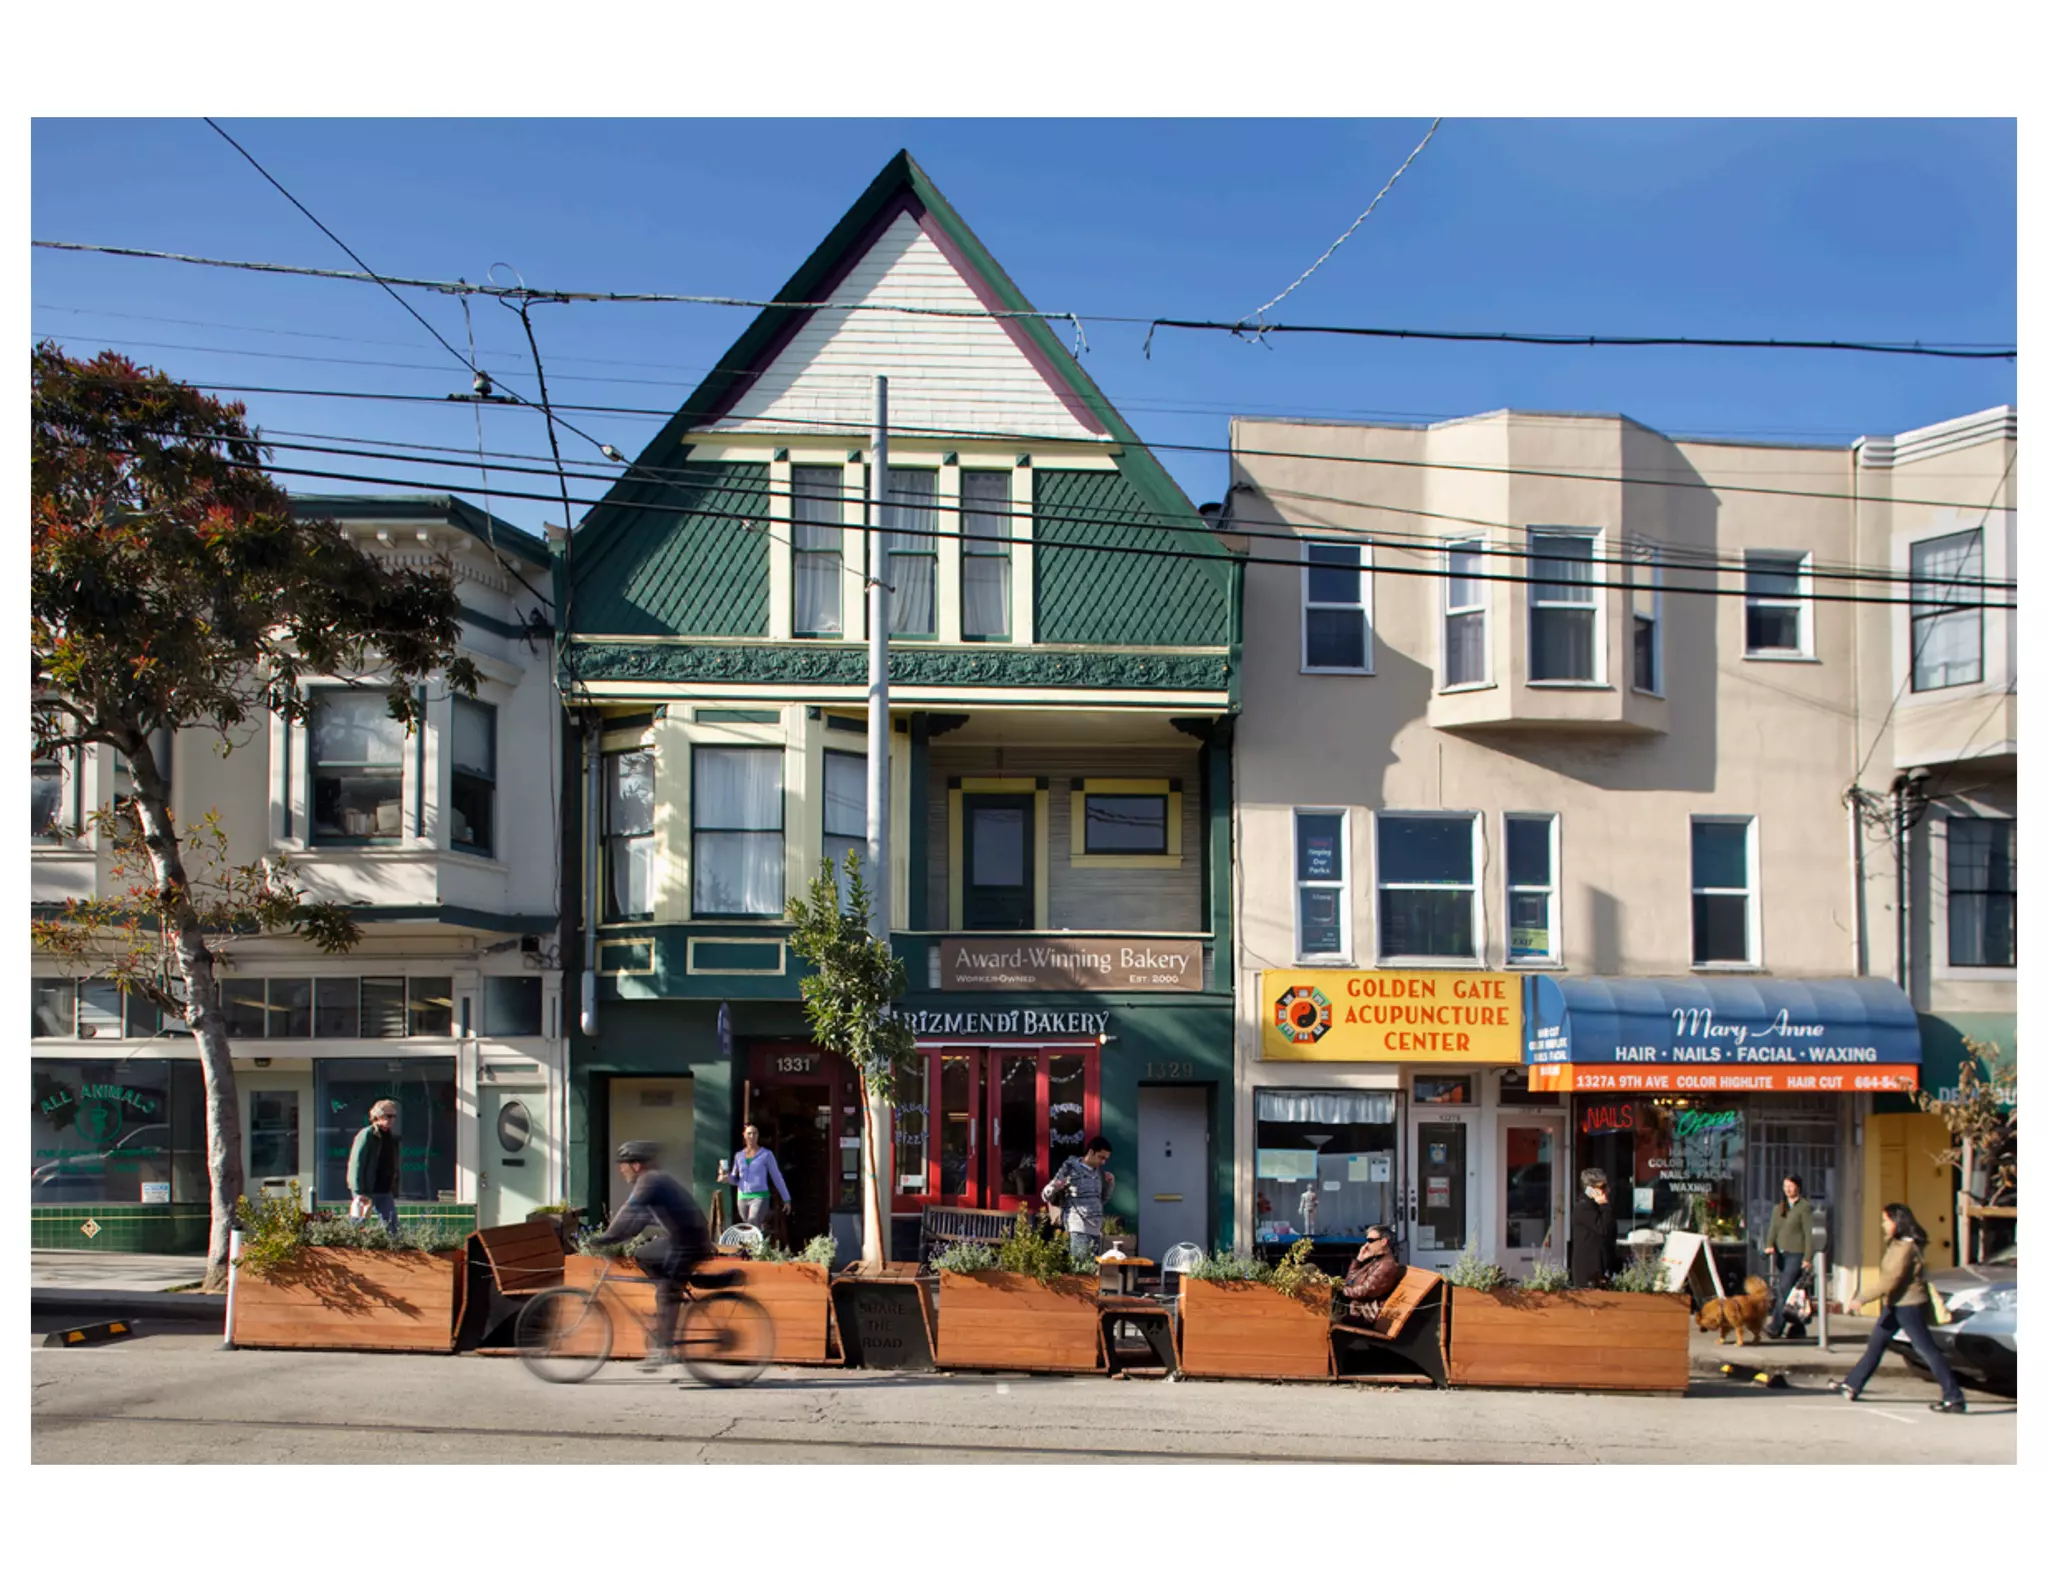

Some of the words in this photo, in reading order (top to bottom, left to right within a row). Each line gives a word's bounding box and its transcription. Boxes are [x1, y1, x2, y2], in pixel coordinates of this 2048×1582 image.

[955, 947, 1112, 974] Award-Winning
[1121, 947, 1190, 974] Bakery
[1347, 979, 1436, 998] GOLDEN
[1453, 980, 1506, 999] GATE
[892, 1010, 1020, 1035] RIZMENDI
[1024, 1010, 1109, 1034] BAKERY
[1345, 1005, 1510, 1026] ACUPUNCTURE
[1672, 1007, 1748, 1045] Mary
[1751, 1008, 1825, 1037] Anne
[1384, 1031, 1470, 1051] CENTER
[1615, 1047, 1657, 1062] HAIR
[1673, 1047, 1722, 1062] NAILS
[1737, 1047, 1797, 1062] FACIAL
[1809, 1047, 1877, 1062] WAXING
[776, 1057, 811, 1072] 1331
[1146, 1062, 1193, 1079] 1329
[1576, 1075, 1615, 1088] 1327A
[1619, 1075, 1643, 1088] 9TH
[1645, 1075, 1669, 1088] AVE
[1676, 1076, 1717, 1088] COLOR
[1720, 1076, 1773, 1089] HIGHLITE
[1787, 1076, 1816, 1089] HAIR
[1819, 1076, 1843, 1089] CUT
[41, 1090, 73, 1114] ALL
[81, 1084, 156, 1114] ANIMALS
[1587, 1104, 1634, 1129] NAILS
[1648, 1158, 1683, 1168] COLOR
[1659, 1169, 1690, 1179] NAILS
[1669, 1182, 1712, 1193] WAXING
[860, 1302, 906, 1315] SHARE
[868, 1320, 893, 1332] THE
[861, 1337, 903, 1349] ROAD
